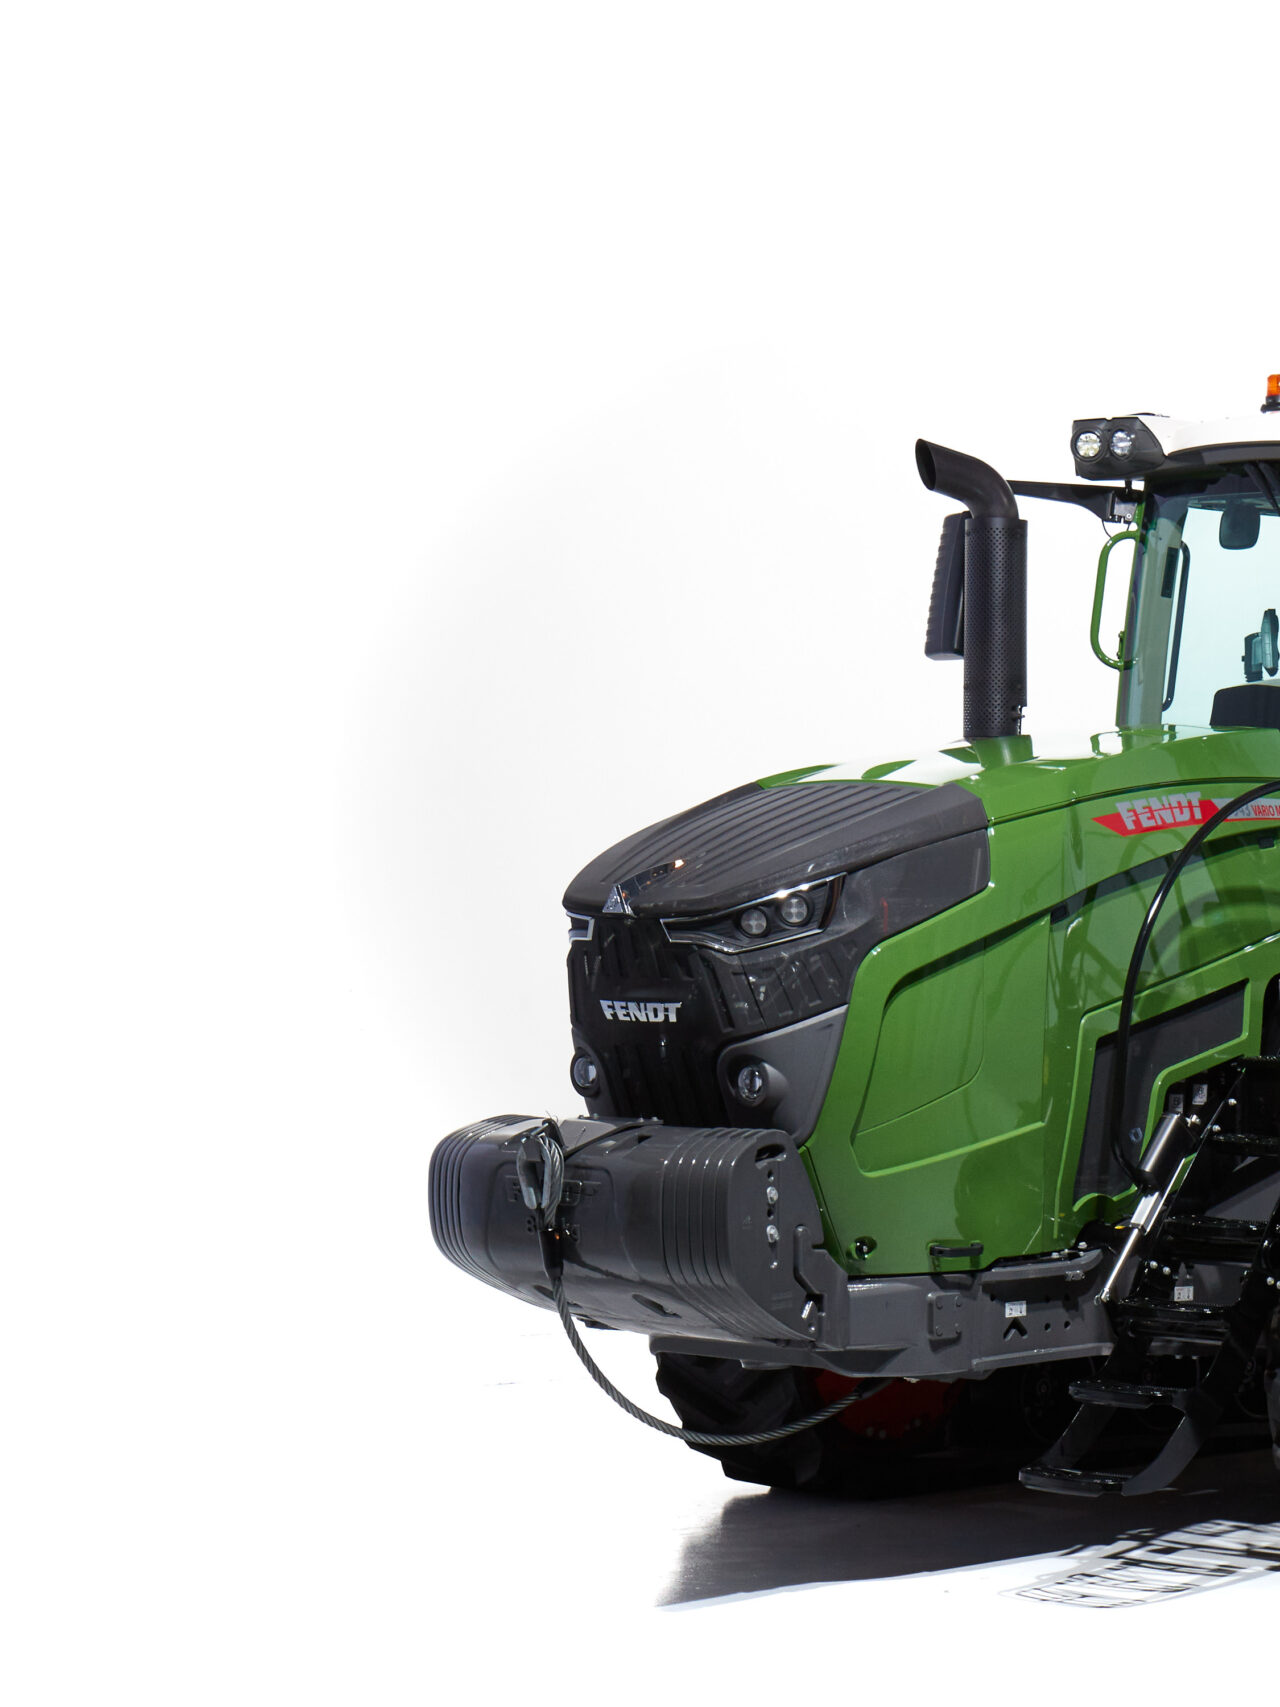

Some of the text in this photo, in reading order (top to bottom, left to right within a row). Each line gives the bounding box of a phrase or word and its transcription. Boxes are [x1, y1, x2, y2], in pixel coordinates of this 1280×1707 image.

[1115, 792, 1202, 830] FENDT
[1251, 804, 1275, 817] VARIO
[600, 1000, 682, 1022] FENDT
